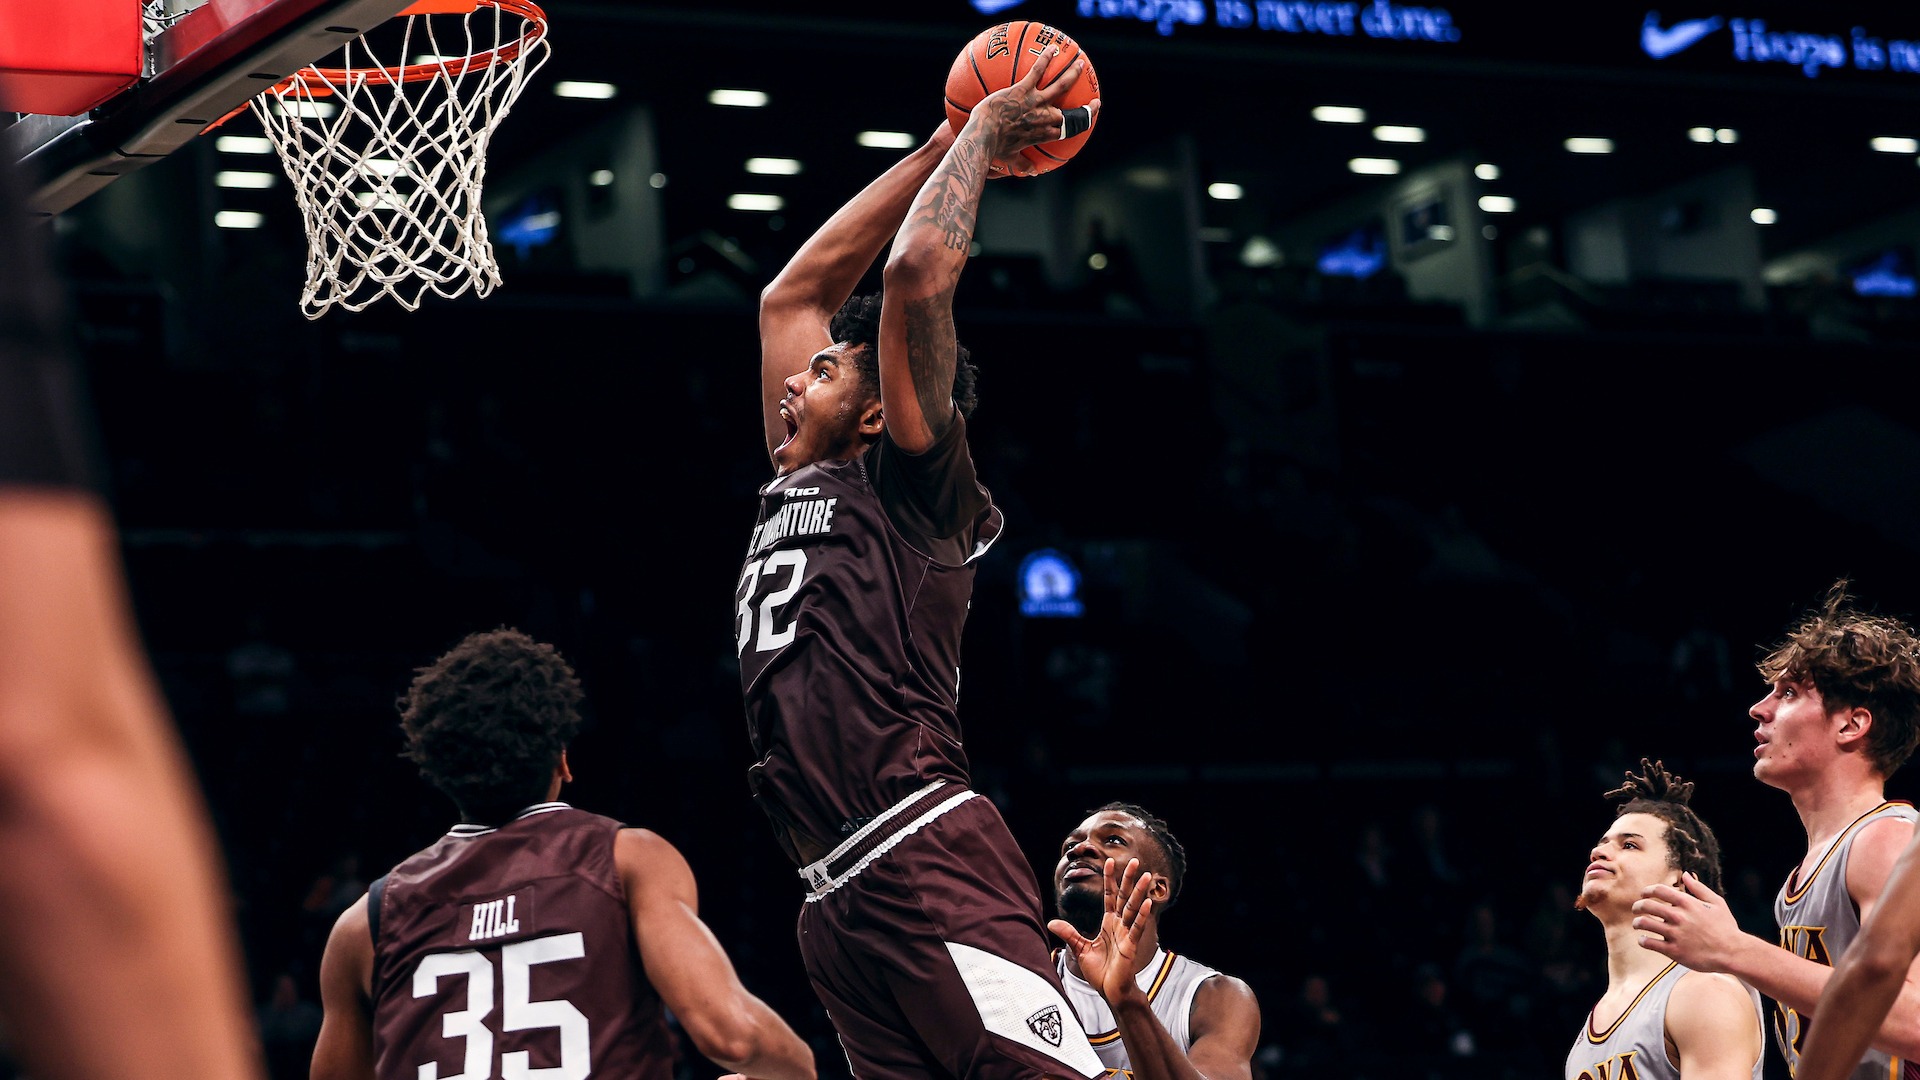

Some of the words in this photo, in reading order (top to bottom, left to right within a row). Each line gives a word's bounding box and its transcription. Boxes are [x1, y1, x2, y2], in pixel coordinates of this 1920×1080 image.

[1257, 0, 1358, 36] never
[1361, 0, 1462, 42] done.
[1729, 17, 1847, 78] Hoops
[1850, 26, 1886, 70] is
[736, 549, 808, 660] 32
[469, 895, 519, 941] HILL
[412, 931, 591, 1080] 35
